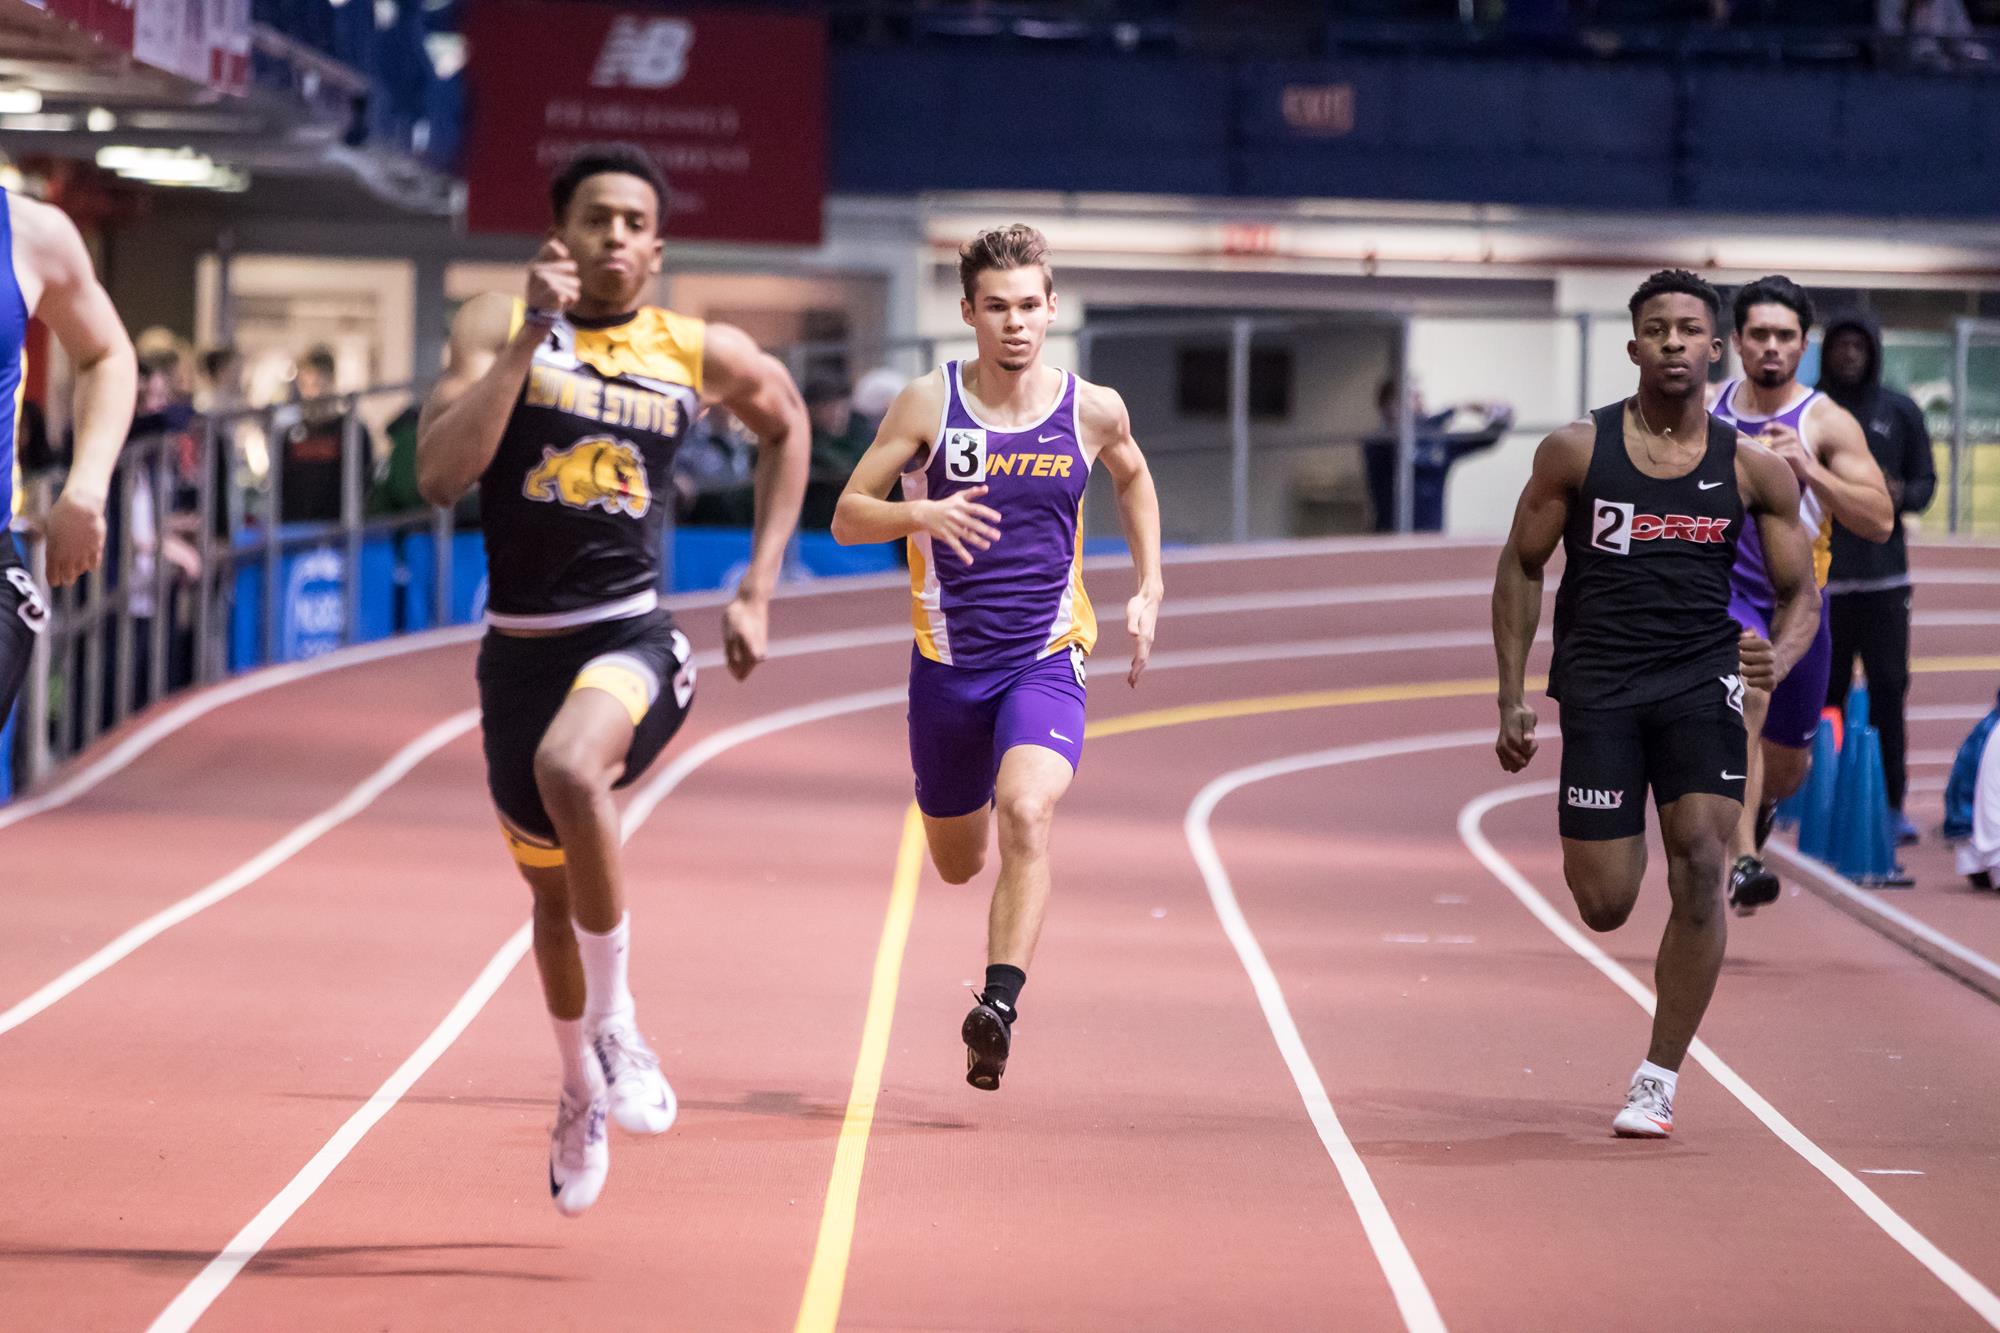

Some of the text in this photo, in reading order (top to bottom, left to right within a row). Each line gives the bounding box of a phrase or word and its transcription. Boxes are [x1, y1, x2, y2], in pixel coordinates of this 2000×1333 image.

[602, 381, 680, 438] STATE
[950, 432, 979, 478] 3
[985, 453, 1074, 478] UNTER
[1595, 505, 1625, 551] 2
[1631, 514, 1732, 544] ORK
[1568, 786, 1625, 808] CUNY
